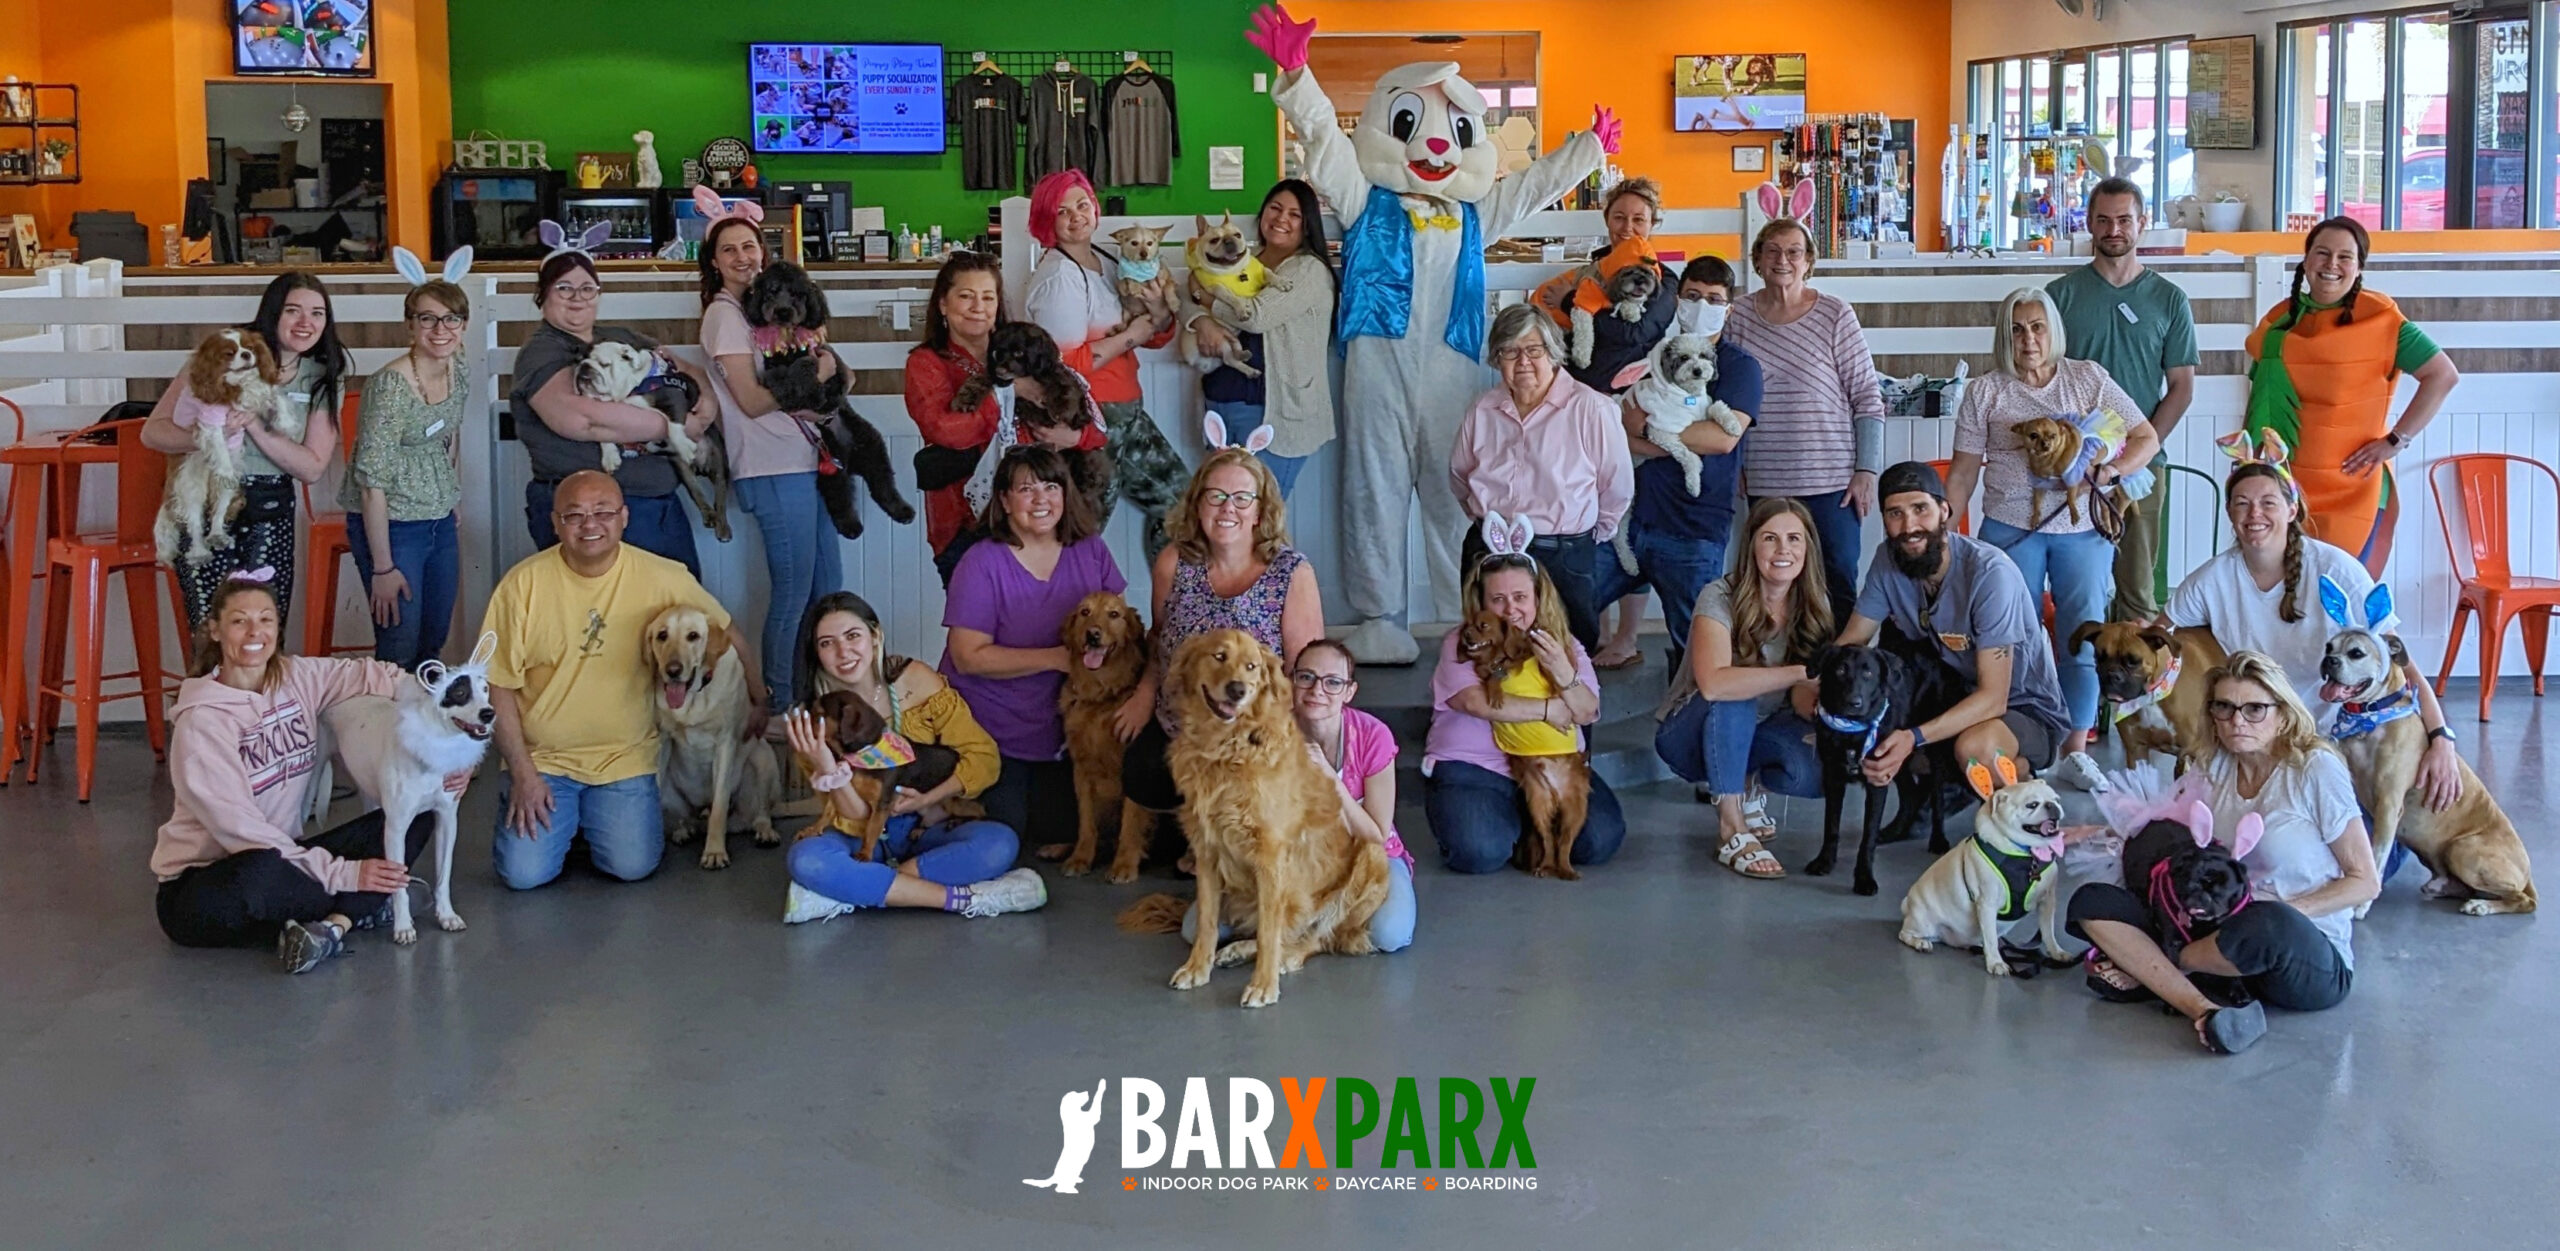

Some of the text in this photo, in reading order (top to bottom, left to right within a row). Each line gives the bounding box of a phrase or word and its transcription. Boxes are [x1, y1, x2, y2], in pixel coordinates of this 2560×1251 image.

[863, 74, 938, 83] PUPPY SOCIALIZATION
[865, 85, 885, 95] EVERY
[886, 85, 912, 95] SUNDAY
[922, 85, 937, 95] 2PM
[453, 140, 552, 173] BEER
[2287, 214, 2318, 232] FREE
[664, 377, 687, 390] LOLA
